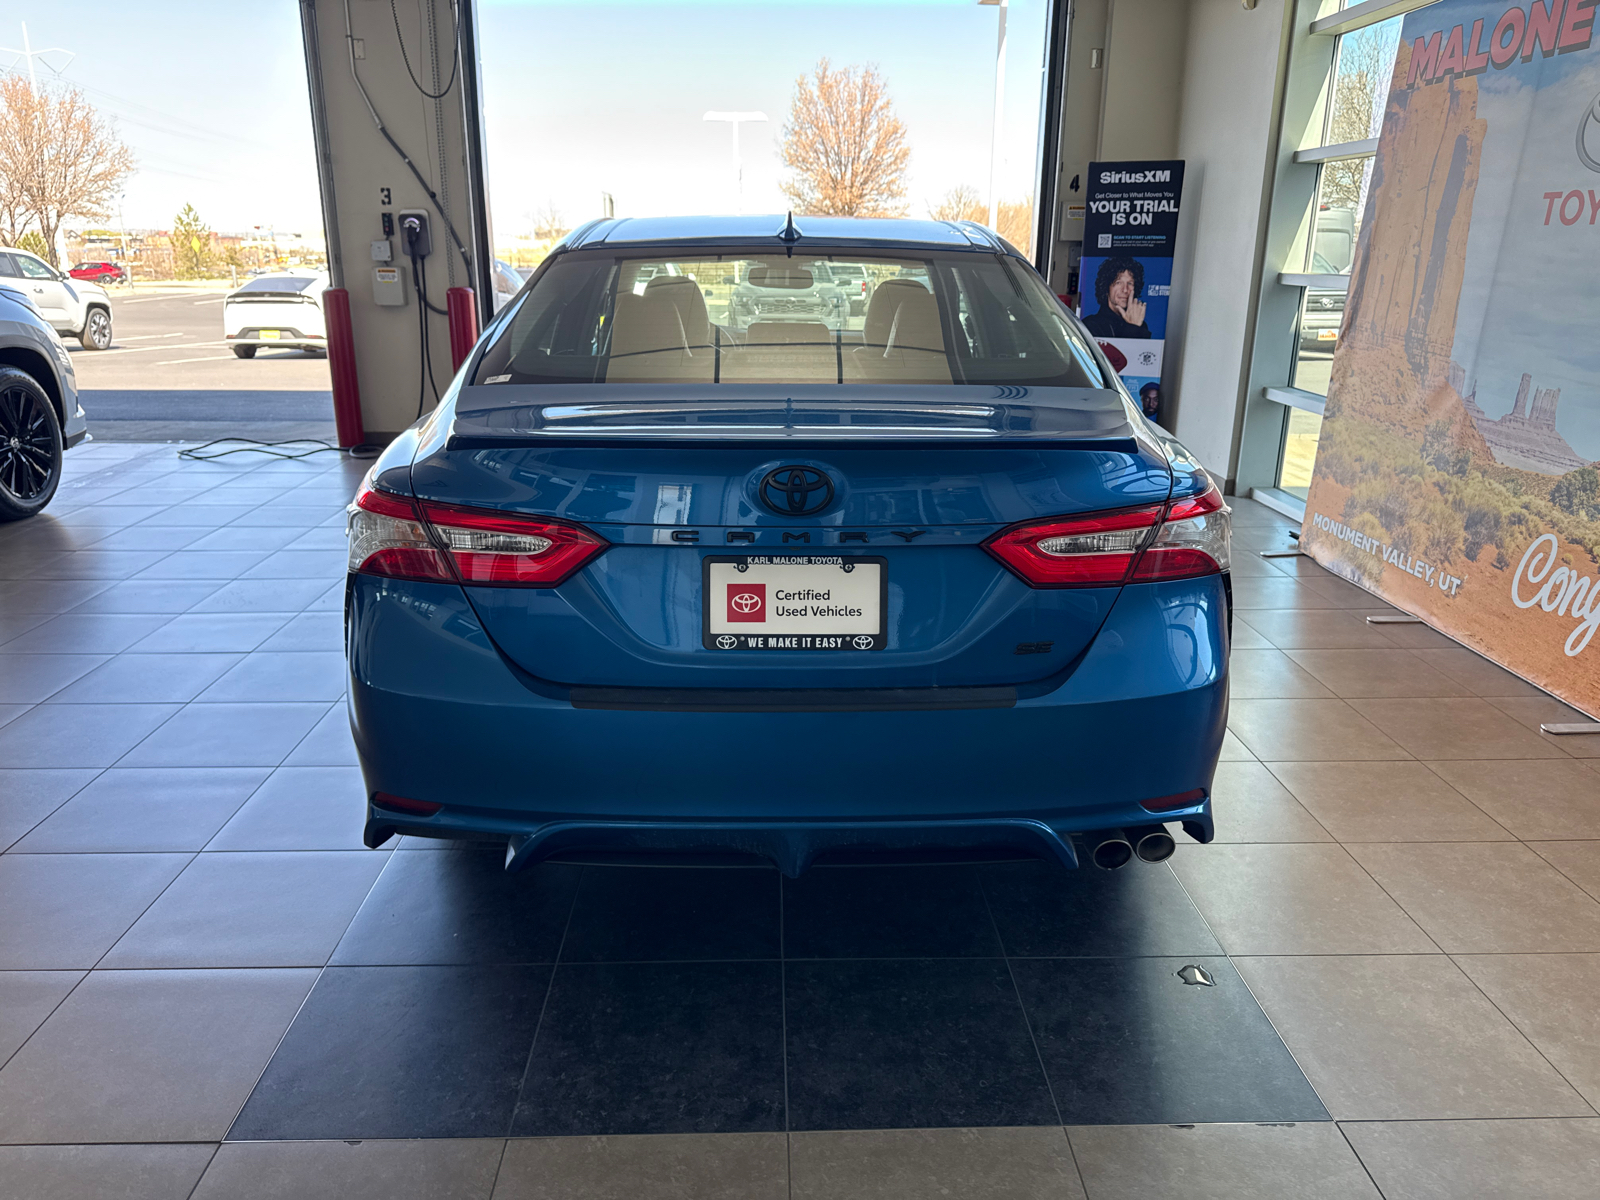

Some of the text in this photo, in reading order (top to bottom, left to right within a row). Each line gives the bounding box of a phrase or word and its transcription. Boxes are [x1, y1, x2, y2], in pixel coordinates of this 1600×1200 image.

[1406, 0, 1600, 90] MALONE
[1069, 174, 1080, 193] 4
[1100, 170, 1171, 184] SiriusXM
[380, 187, 391, 205] 3
[1089, 200, 1179, 213] YOUR TRIAL
[1112, 213, 1153, 225] IS ON
[671, 530, 927, 543] CAMRY
[747, 556, 843, 565] KARL MALONE TOYOTA
[1312, 512, 1462, 596] MONUMENT VALLEY, UT
[775, 589, 831, 601] Certified
[776, 605, 862, 617] Used Vehicles
[747, 637, 843, 648] WE MAKE IT EASY
